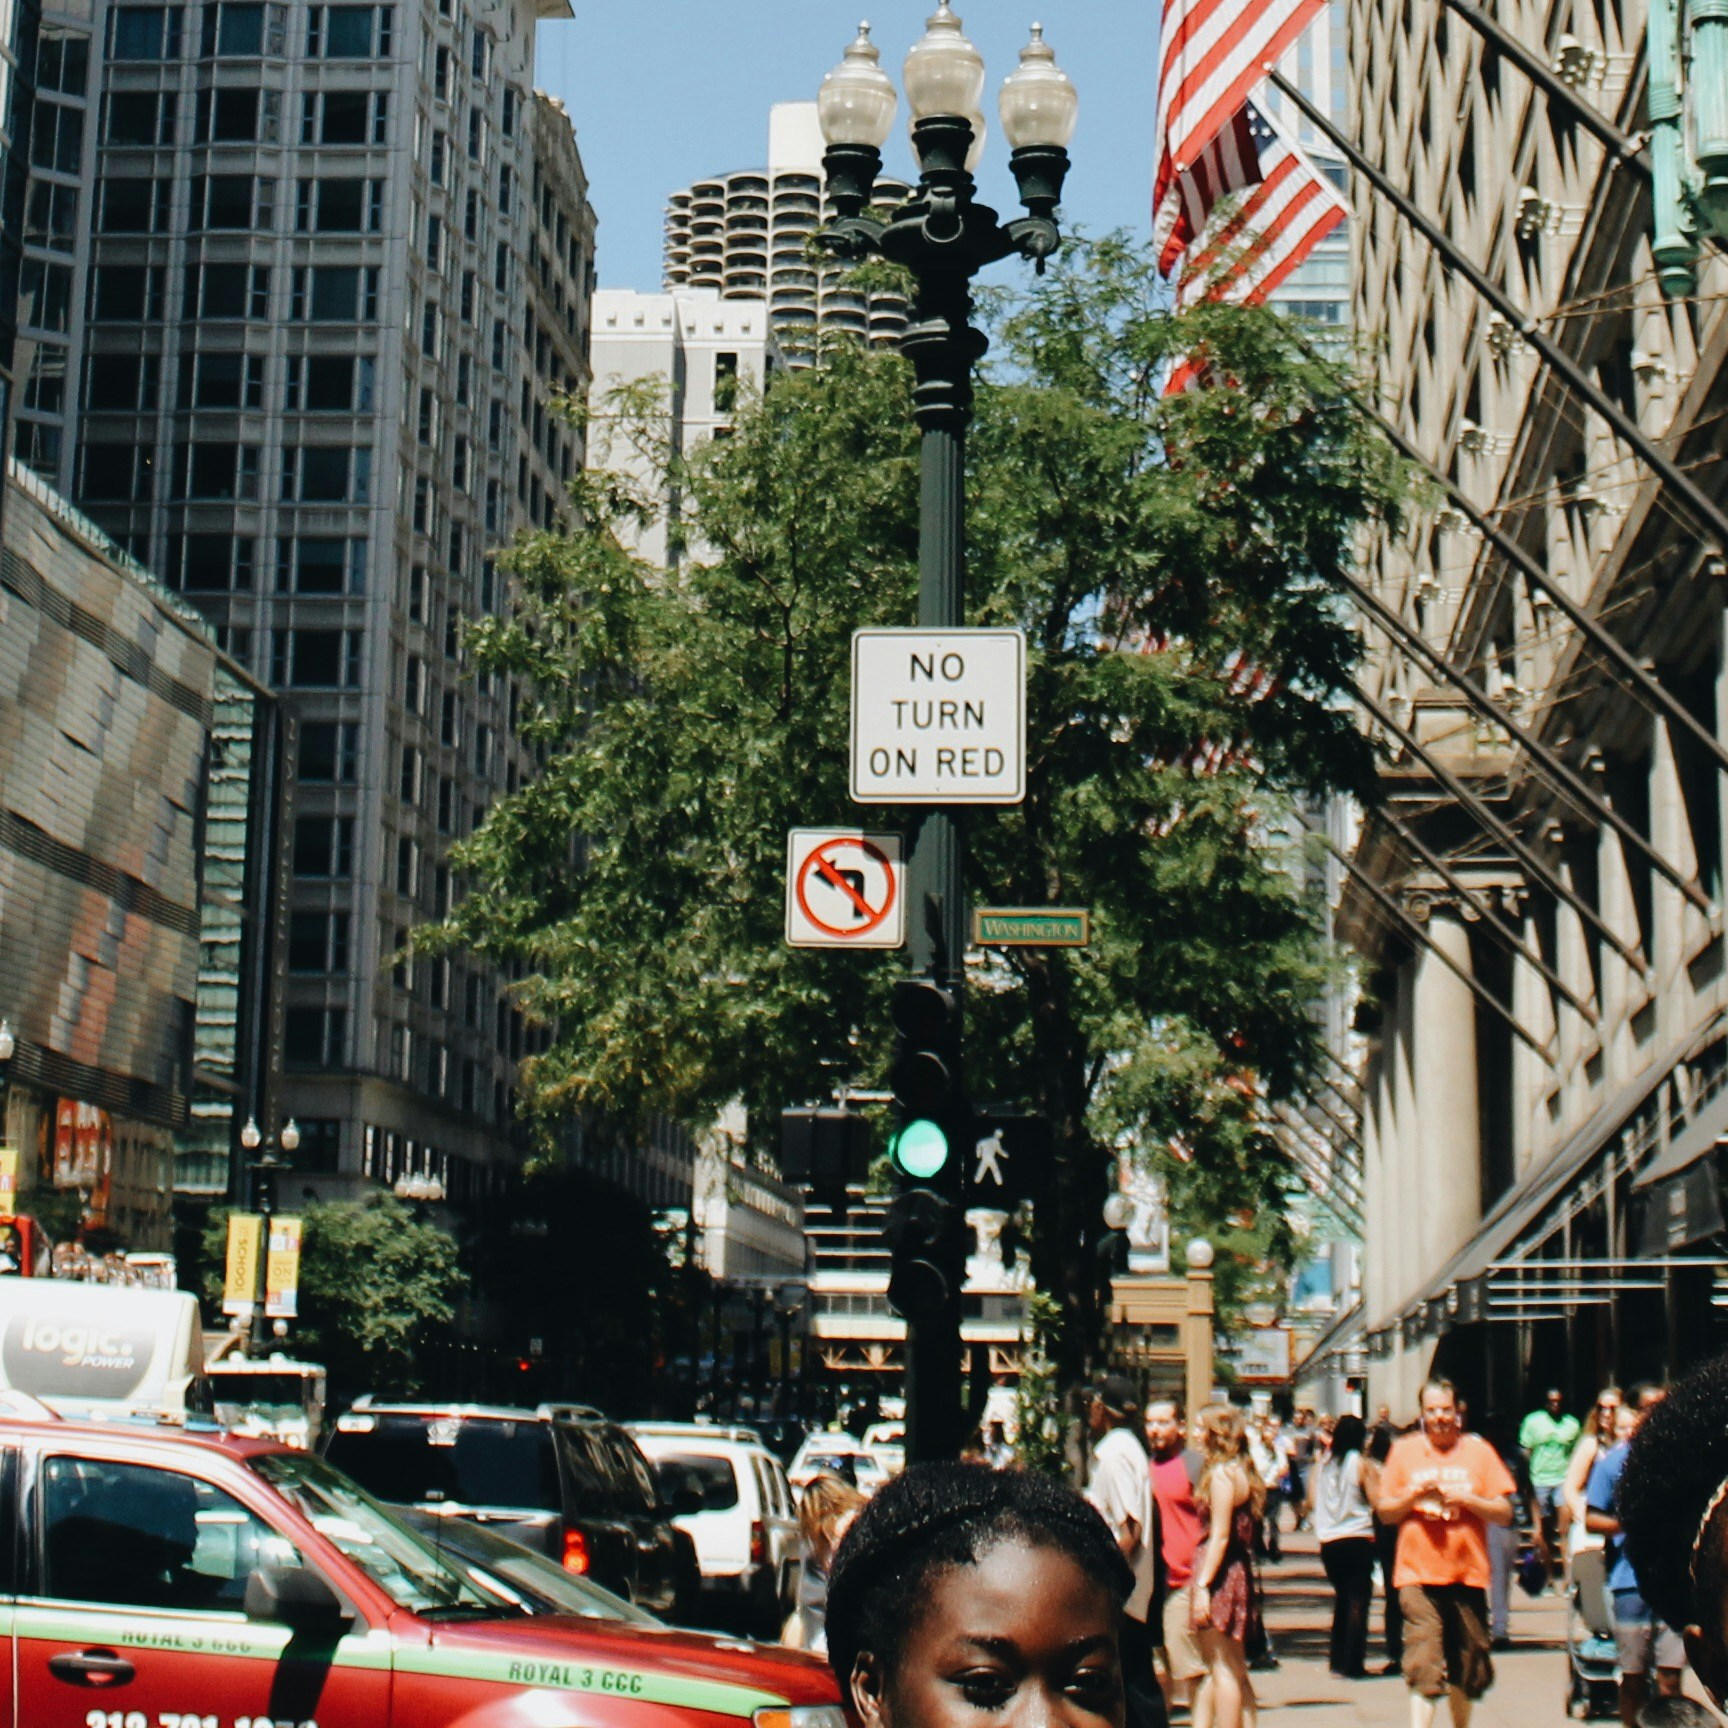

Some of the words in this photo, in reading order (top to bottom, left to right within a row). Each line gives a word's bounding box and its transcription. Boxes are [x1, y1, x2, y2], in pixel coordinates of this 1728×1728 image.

[910, 653, 965, 681] NO
[892, 700, 984, 729] TURN
[869, 747, 917, 777] ON
[936, 748, 1005, 777] RED
[983, 920, 1080, 939] WASHINGTON
[80, 1355, 136, 1370] POWER
[509, 1661, 572, 1685] ROYAL
[581, 1670, 593, 1687] 3
